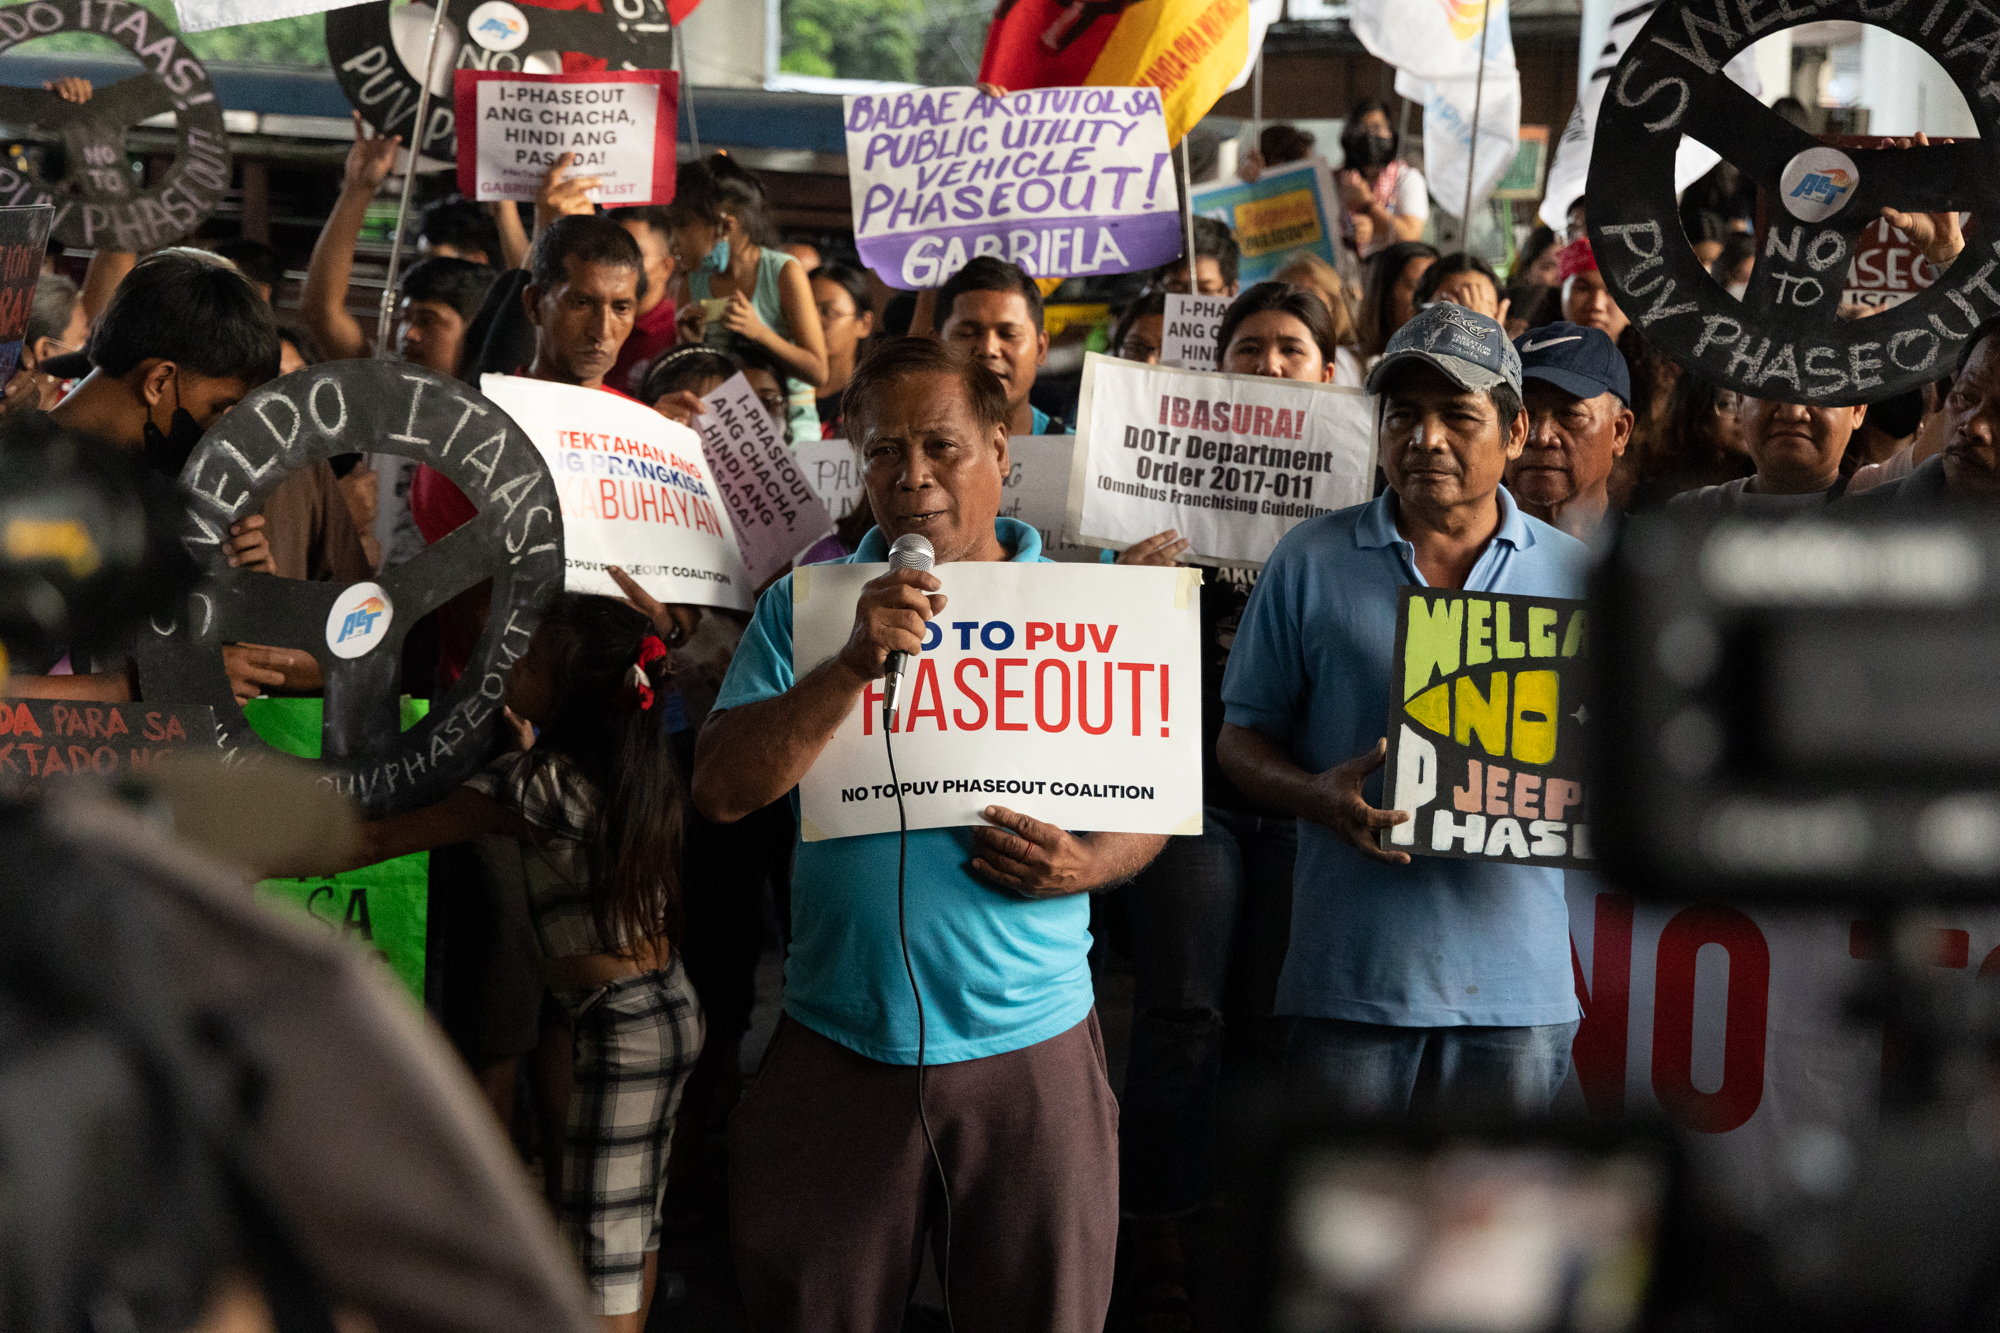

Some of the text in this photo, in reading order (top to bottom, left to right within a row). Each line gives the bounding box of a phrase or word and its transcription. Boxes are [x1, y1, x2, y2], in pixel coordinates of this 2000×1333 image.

[486, 107, 636, 126] ANG CHACHA,
[500, 86, 625, 105] I-PHASEOUT
[849, 91, 961, 132] BABAE
[1123, 91, 1162, 117] SA
[505, 128, 617, 146] HINDI ANG
[515, 150, 606, 167] PASDA!
[864, 119, 1139, 171] PUBLIC UTILITY
[917, 147, 1097, 190] VEHICLE
[858, 153, 1169, 234] PHASEOUT!
[902, 227, 1130, 288] GABRIELA
[1767, 219, 1847, 271] NO
[1180, 301, 1228, 318] I-PHA
[1602, 218, 2000, 398] PUV PHASEOUT
[1771, 271, 1825, 307] TO
[1168, 322, 1205, 339] ANG
[1159, 395, 1306, 440] IBASURA!
[389, 375, 558, 564] ITAAS!
[711, 397, 797, 532] ANG CHACHA,
[737, 394, 813, 505] I-PHASEOUT
[1123, 425, 1334, 473] DOTr Department
[591, 454, 711, 498] PRANGKISA
[703, 424, 745, 481] HINDI
[741, 483, 775, 528] ANG
[1136, 456, 1314, 499] Order 2017-011
[1170, 489, 1258, 515] Franchising
[601, 563, 669, 576] PSEOUT
[672, 566, 731, 586] COALITION
[952, 621, 1015, 651] TO
[1025, 622, 1119, 653] PUV
[862, 657, 1170, 738] HASEOUT!
[53, 705, 129, 739] PARA
[143, 711, 187, 742] SA
[842, 779, 1155, 803] NO TO PUV PHASEOUT COALITION
